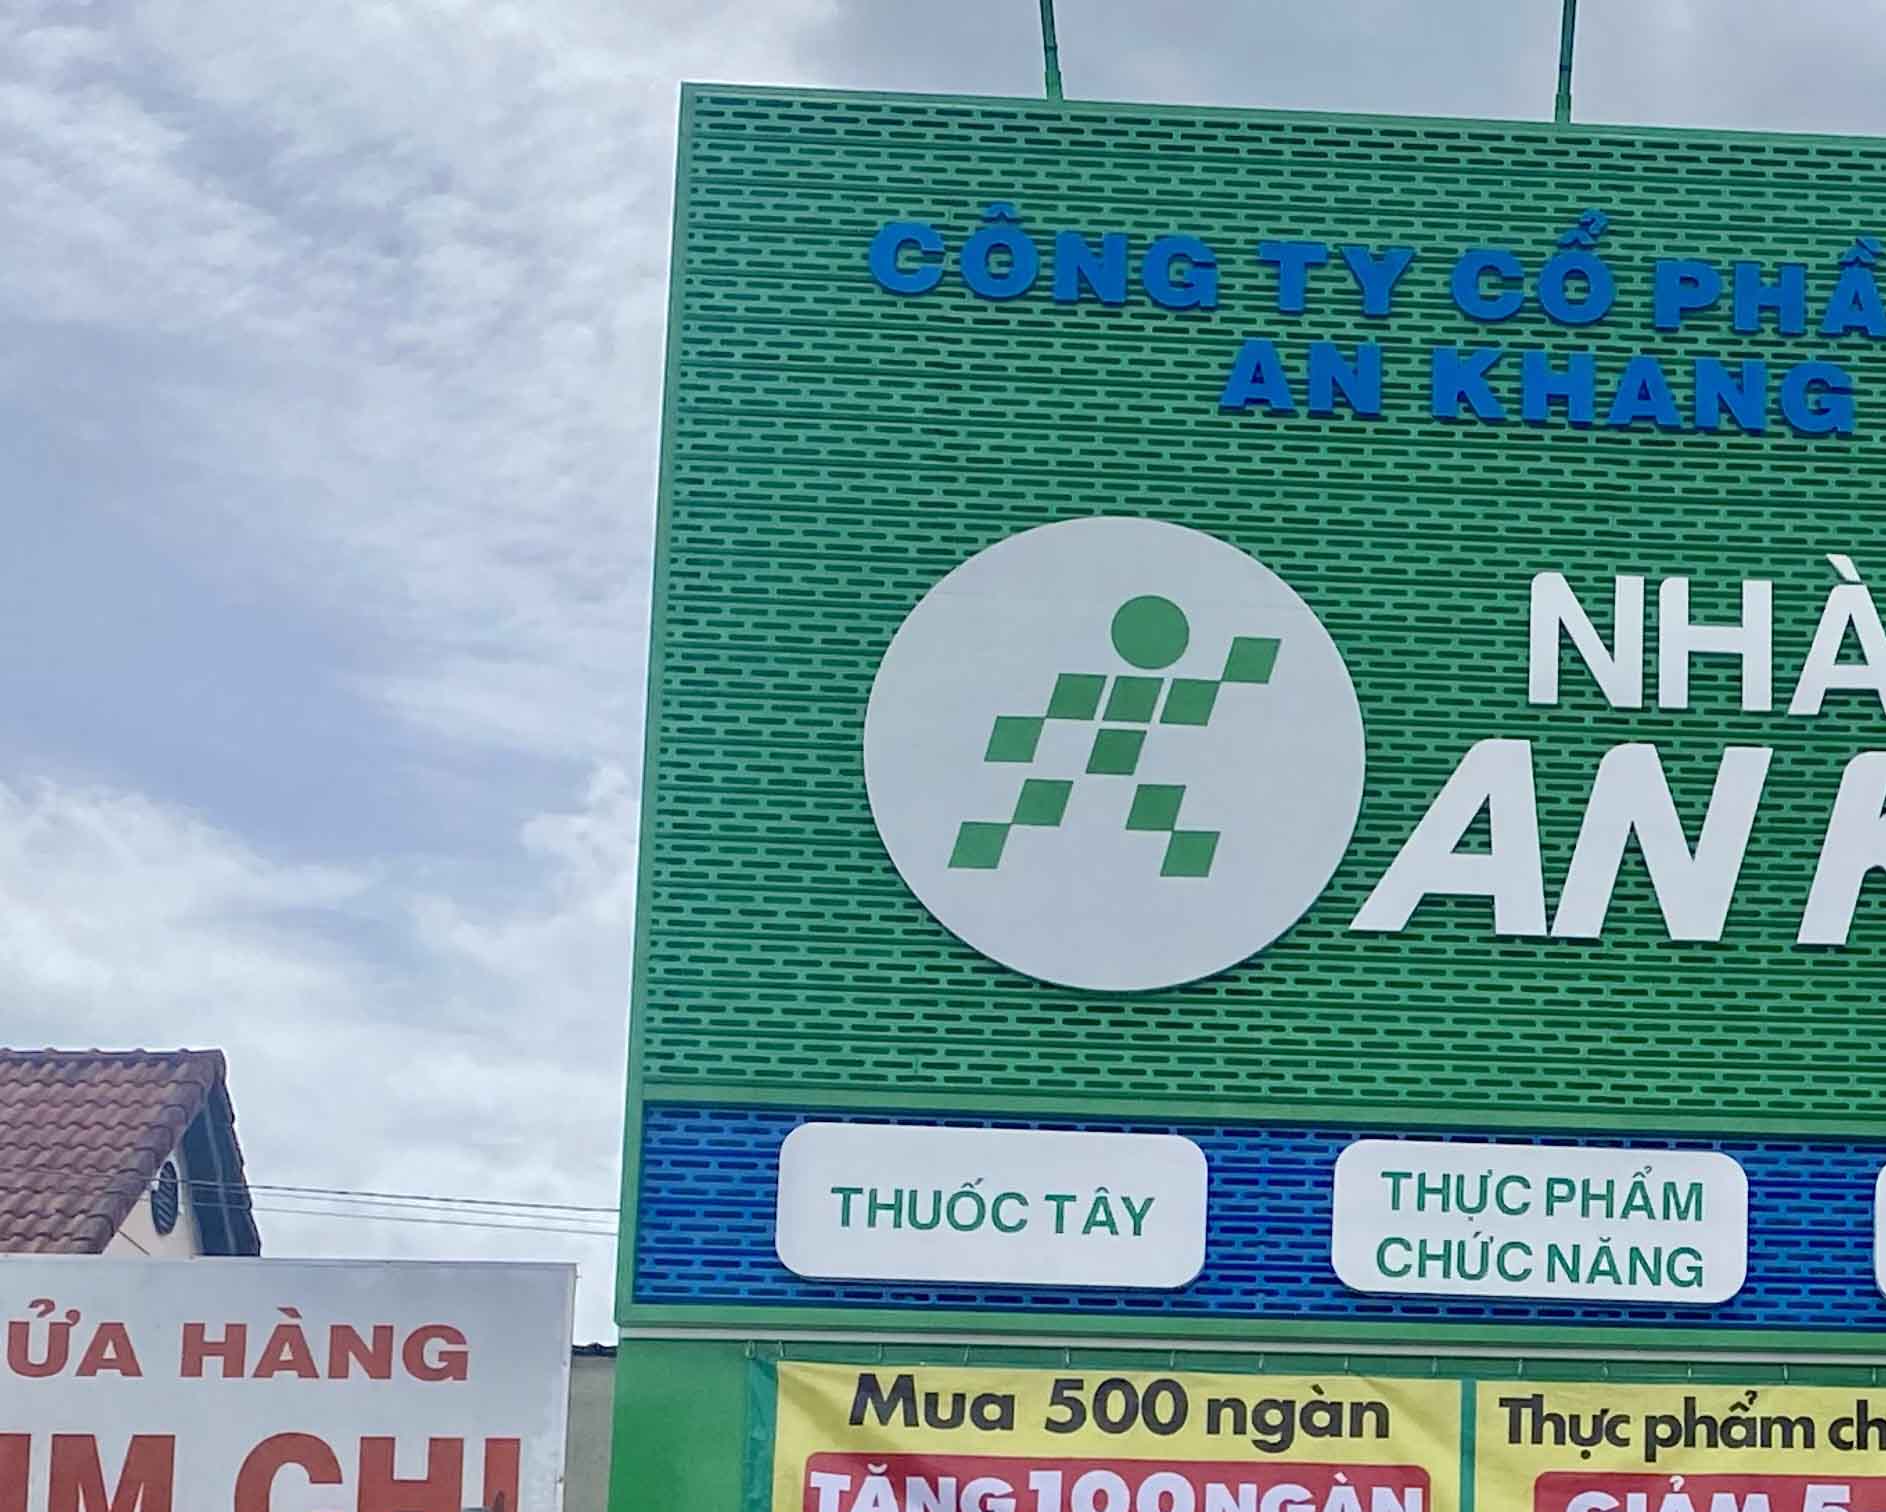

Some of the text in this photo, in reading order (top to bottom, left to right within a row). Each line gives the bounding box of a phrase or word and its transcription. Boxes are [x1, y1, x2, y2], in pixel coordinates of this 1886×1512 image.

[870, 202, 1218, 311] CÔNG
[1260, 241, 1416, 315] TY
[1451, 210, 1616, 327] CỔ
[1221, 340, 1383, 416] AN
[1431, 346, 1855, 437] KHANG
[1348, 737, 1772, 940] AN
[831, 1178, 1156, 1238] THUỐC TÂY
[1380, 1165, 1705, 1228] THỰC PHẨM
[1375, 1231, 1705, 1290] CHỨC NĂNG
[4, 1298, 471, 1381] ỬA HÀNG
[849, 1373, 1387, 1454] Mua 500 ngàn
[1500, 1393, 1631, 1461] Thực
[1643, 1389, 1816, 1464] phẩm
